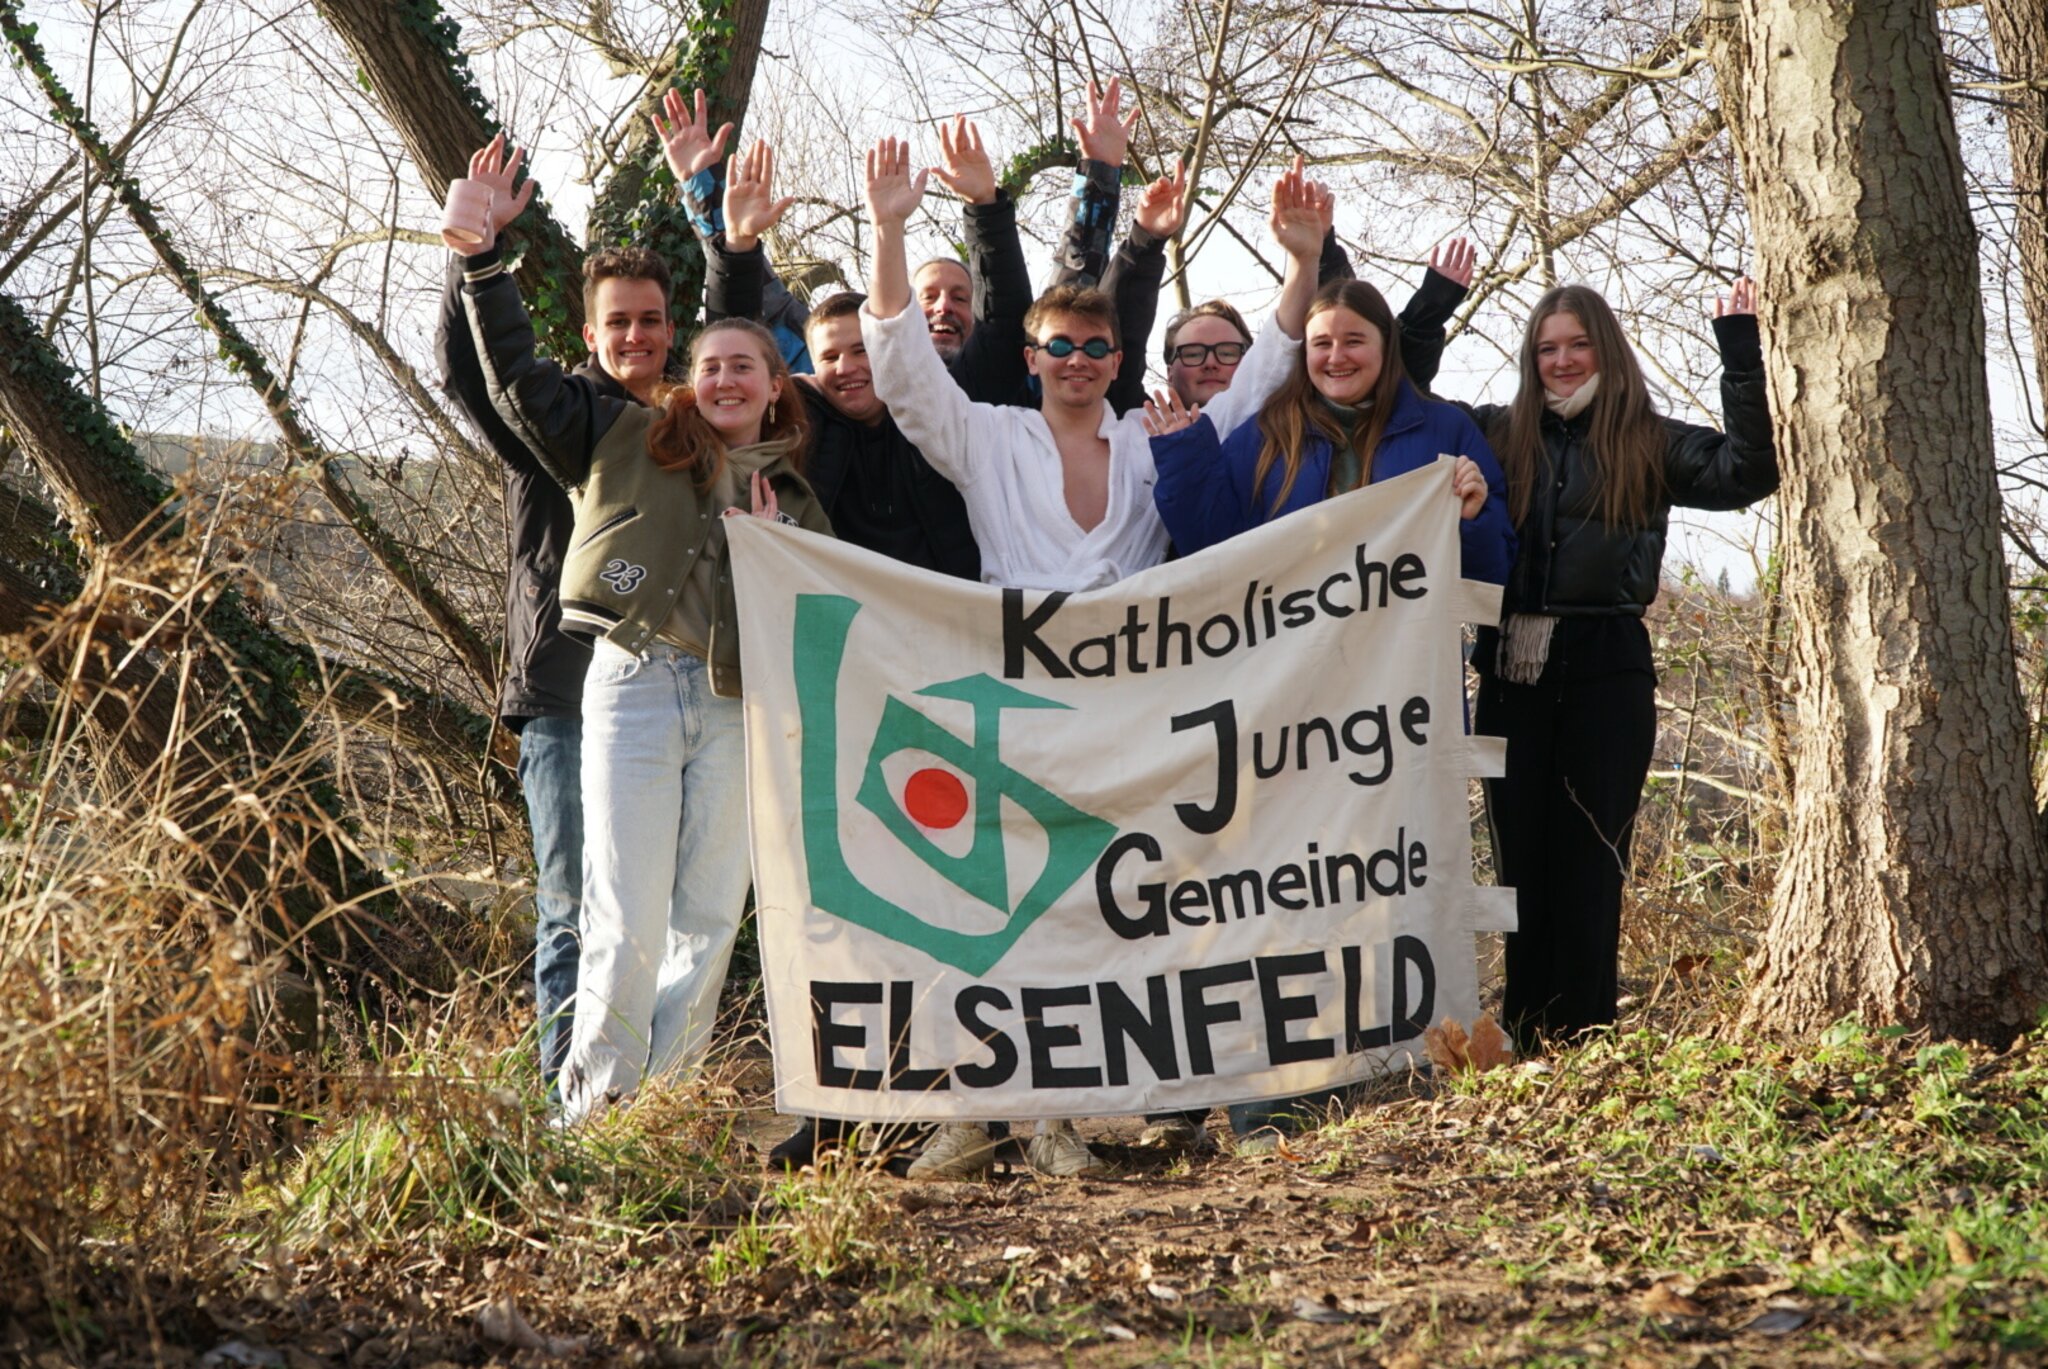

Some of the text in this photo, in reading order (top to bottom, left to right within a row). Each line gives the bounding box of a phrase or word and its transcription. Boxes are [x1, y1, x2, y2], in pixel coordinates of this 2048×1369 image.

[599, 558, 647, 595] 23
[1002, 543, 1429, 680] Katholische
[1170, 696, 1431, 835] Junge
[1096, 827, 1428, 940] Gemeinde
[811, 935, 1437, 1091] ELSENFELD
